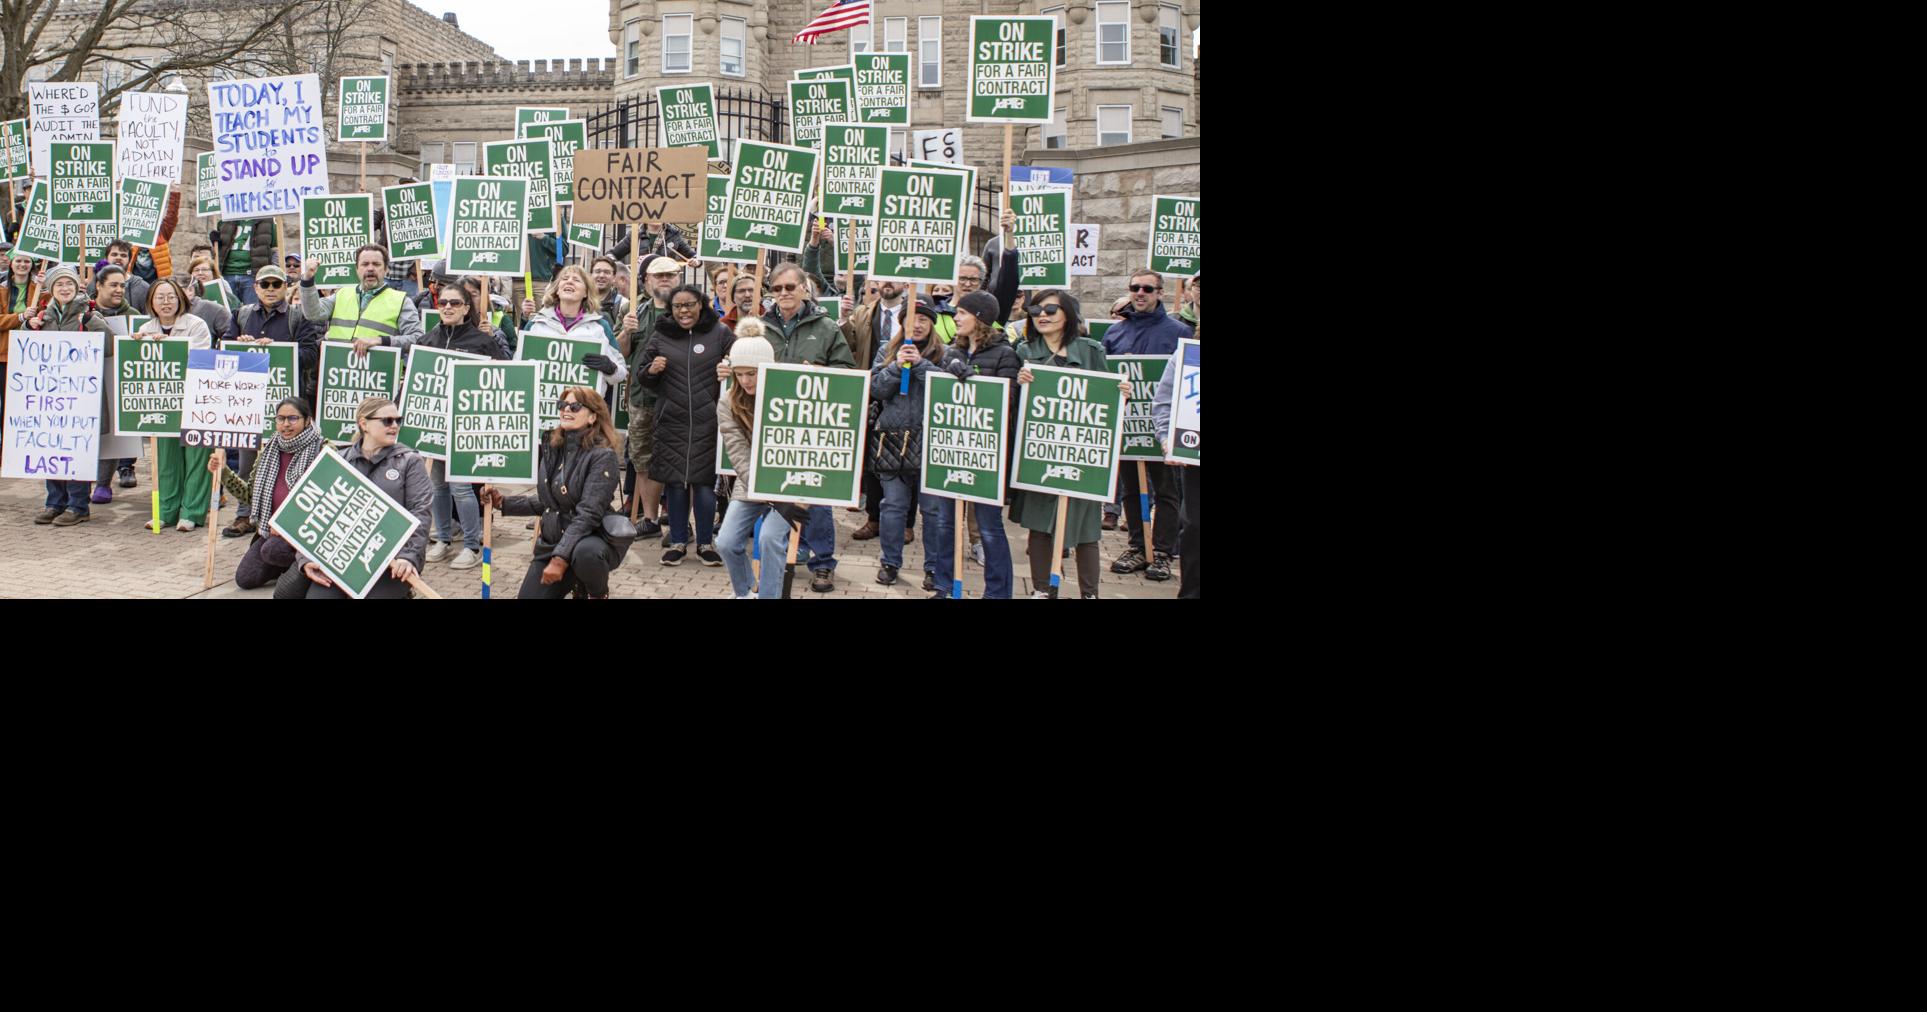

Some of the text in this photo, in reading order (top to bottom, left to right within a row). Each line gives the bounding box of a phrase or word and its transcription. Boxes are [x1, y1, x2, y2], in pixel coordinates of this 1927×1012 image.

[999, 22, 1024, 41] ON
[979, 42, 1043, 61] STRIKE
[872, 56, 889, 70] ON
[977, 64, 1046, 77] FOR FAIR
[858, 70, 902, 83] STRIKE
[31, 86, 88, 100] WHERE'D
[356, 81, 370, 91] ON
[809, 85, 827, 98] ON
[885, 85, 904, 94] FAIR
[978, 81, 1044, 94] CONTRACT
[212, 81, 305, 108] TODAY, I
[345, 92, 381, 104] STRIKE
[677, 90, 692, 103] ON
[33, 102, 96, 114] THE $ GO?
[129, 94, 178, 113] FUND
[343, 105, 383, 114] FOR FAIR
[666, 103, 708, 119] STRIKE
[796, 100, 841, 114] STRIKE
[215, 106, 312, 133] TEACH MY
[344, 115, 382, 124] CONTRACT
[534, 112, 549, 122] ON
[667, 119, 712, 130] FOR FAIR
[796, 117, 813, 126] FOR
[34, 120, 98, 132] AUDIT THE
[545, 126, 562, 141] ON
[135, 139, 155, 149] NOT
[218, 127, 319, 152] STUDENTS
[670, 130, 713, 143] CONTRACT
[844, 130, 865, 145] ON
[70, 146, 90, 160] ON
[122, 151, 174, 164] ADMIN
[507, 146, 526, 162] ON
[763, 151, 787, 170] ON
[829, 147, 879, 164] STRIKE
[55, 160, 106, 176] STRIKE
[221, 154, 320, 181] STAND UP
[492, 162, 543, 177] STRIKE
[607, 151, 662, 173] FAIR
[741, 166, 803, 191] STRIKE
[827, 167, 846, 179] FOR
[54, 178, 110, 189] FOR FAIR
[136, 182, 151, 195] ON
[477, 182, 500, 200] ON
[578, 174, 695, 201] CONTRACT
[907, 176, 934, 196] ON
[55, 190, 109, 202] CONTRACT
[123, 192, 159, 209] STRIKE
[400, 189, 415, 202] ON
[736, 189, 802, 206] FOR A FAIR
[324, 201, 345, 216] ON
[390, 201, 428, 218] STRIKE
[460, 200, 516, 218] STRIKE
[611, 202, 666, 221] NOW
[884, 196, 952, 218] STRIKE
[1023, 197, 1042, 214] ON
[1175, 202, 1194, 216] ON
[735, 205, 800, 224] CONTRACT
[96, 224, 115, 233] FAIR
[309, 218, 362, 233] STRIKE
[391, 215, 432, 230] FOR FAIR
[457, 221, 519, 233] FOR FAIR
[882, 220, 906, 235] FOR
[924, 222, 953, 235] FAIR
[392, 228, 433, 241] CONTRACT
[457, 236, 517, 248] CONTRACT
[1040, 234, 1062, 246] FAIR
[1076, 229, 1088, 248] R
[1157, 233, 1174, 242] FOR
[308, 236, 366, 250] FOR FAIR
[882, 238, 952, 253] CONTRACT
[1072, 255, 1094, 266] ACT
[18, 337, 52, 365] YOU
[141, 343, 163, 360] ON
[547, 341, 573, 361] ON
[348, 351, 369, 369] ON
[40, 365, 66, 375] PUT
[124, 362, 180, 379] STRIKE
[1118, 362, 1143, 380] ON
[10, 373, 98, 393] STUDENTS
[198, 379, 231, 390] MORE
[328, 370, 386, 390] STRIKE
[480, 368, 505, 389] ON
[122, 382, 184, 395] FOR FAIR
[796, 375, 828, 400] ON
[952, 382, 976, 406] ON
[1058, 376, 1088, 400] ON
[26, 395, 77, 411] FIRST
[124, 397, 183, 410] CONTRACT
[195, 395, 252, 407] LESS PAY?
[325, 392, 359, 403] FOR A
[409, 396, 430, 408] FOR
[458, 390, 525, 412] STRIKE
[192, 411, 216, 424] NO
[769, 398, 851, 427] STRIKE
[933, 402, 994, 430] STRIKE
[1032, 396, 1109, 427] STRIKE
[47, 416, 67, 428] YOU
[72, 416, 98, 429] PUT
[456, 416, 528, 431] FOR FAIR
[16, 431, 92, 451] FACULTY
[188, 431, 256, 448] ON STRIKE
[764, 428, 853, 447] FOR FAIR
[931, 430, 996, 449] FOR FAIR
[1027, 422, 1110, 445] FOR FAIR
[1184, 434, 1197, 444] ON
[457, 436, 528, 450] CONTRACT
[764, 450, 850, 468] CONTRACT
[931, 448, 995, 469] CONTRACT
[1027, 442, 1107, 466] CONTRACT
[25, 455, 75, 475] LAST.
[297, 479, 324, 512] ON
[298, 477, 350, 544] STRIKE
[316, 487, 372, 559] FOR FAIR
[333, 501, 378, 571] CONTRACT
